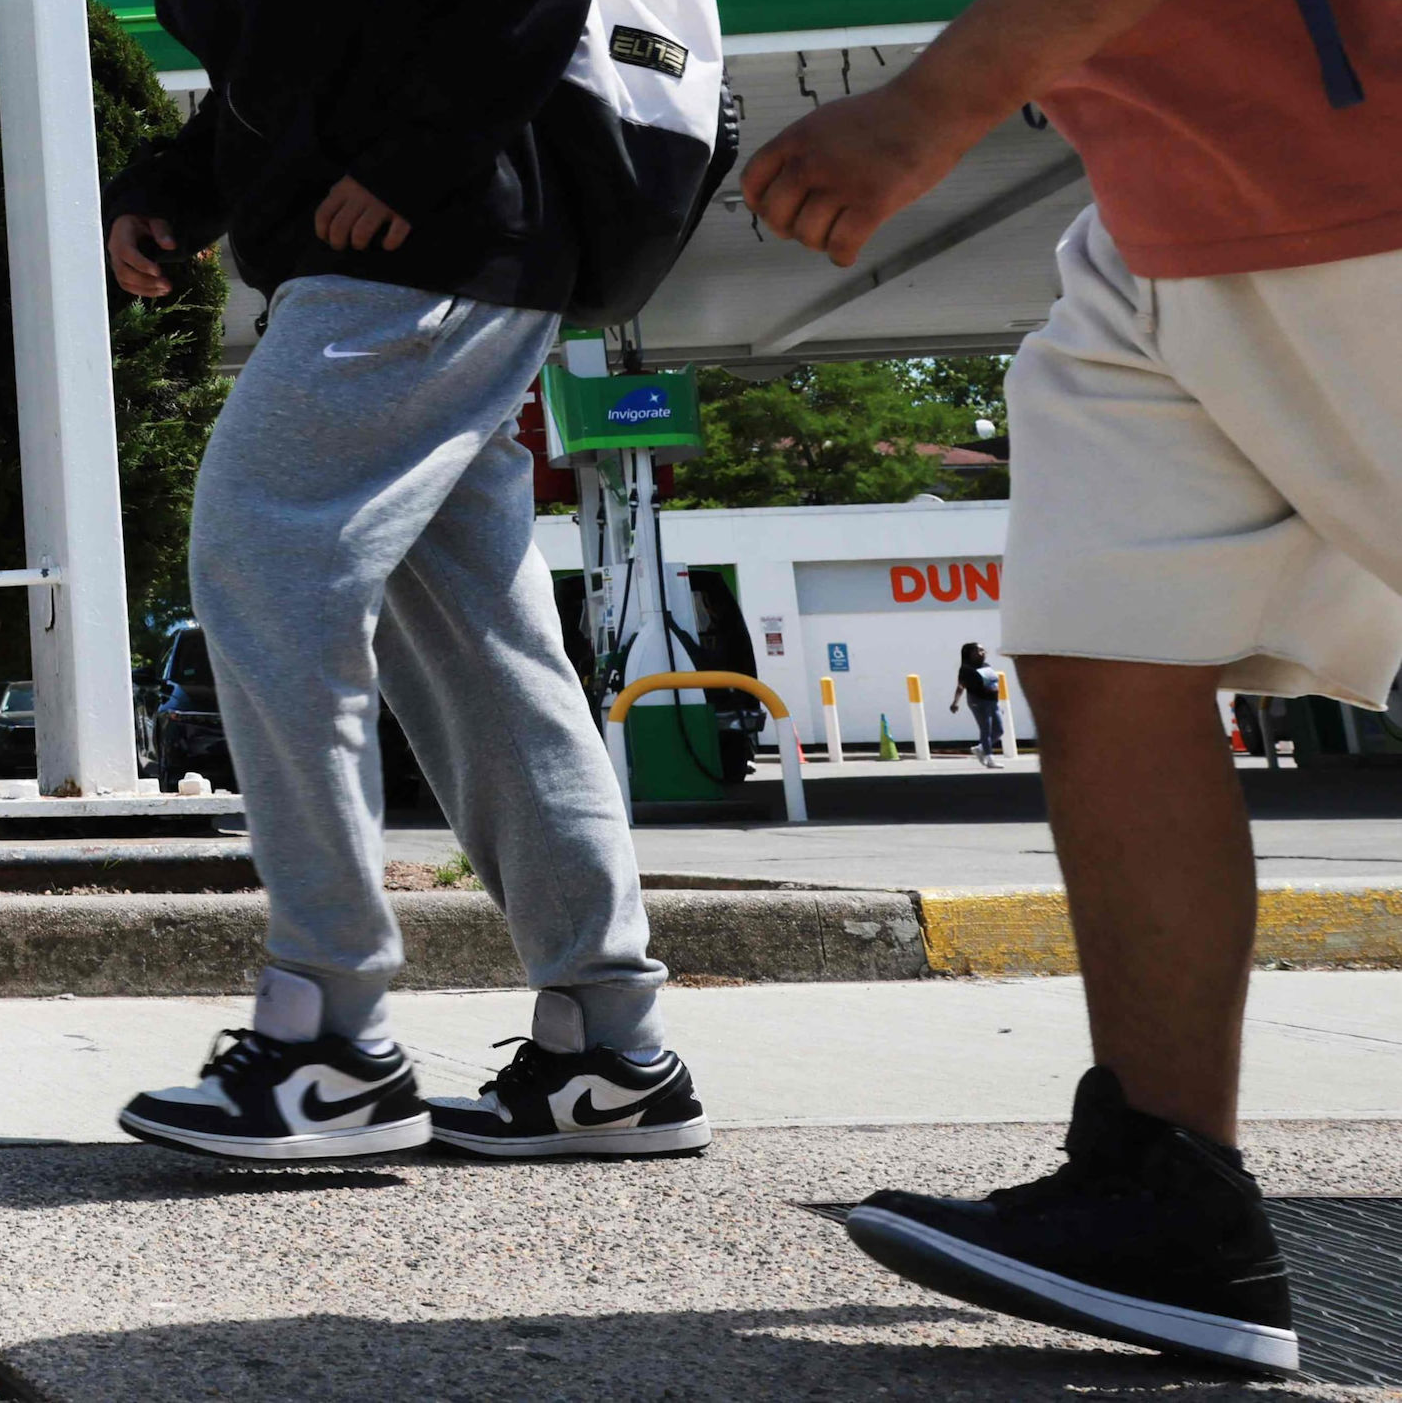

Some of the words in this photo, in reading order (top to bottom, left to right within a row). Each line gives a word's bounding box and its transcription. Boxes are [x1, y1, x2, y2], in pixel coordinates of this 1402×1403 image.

[612, 35, 686, 70] ELITE
[608, 407, 671, 422] Invigorate
[890, 562, 1003, 603] DUN
